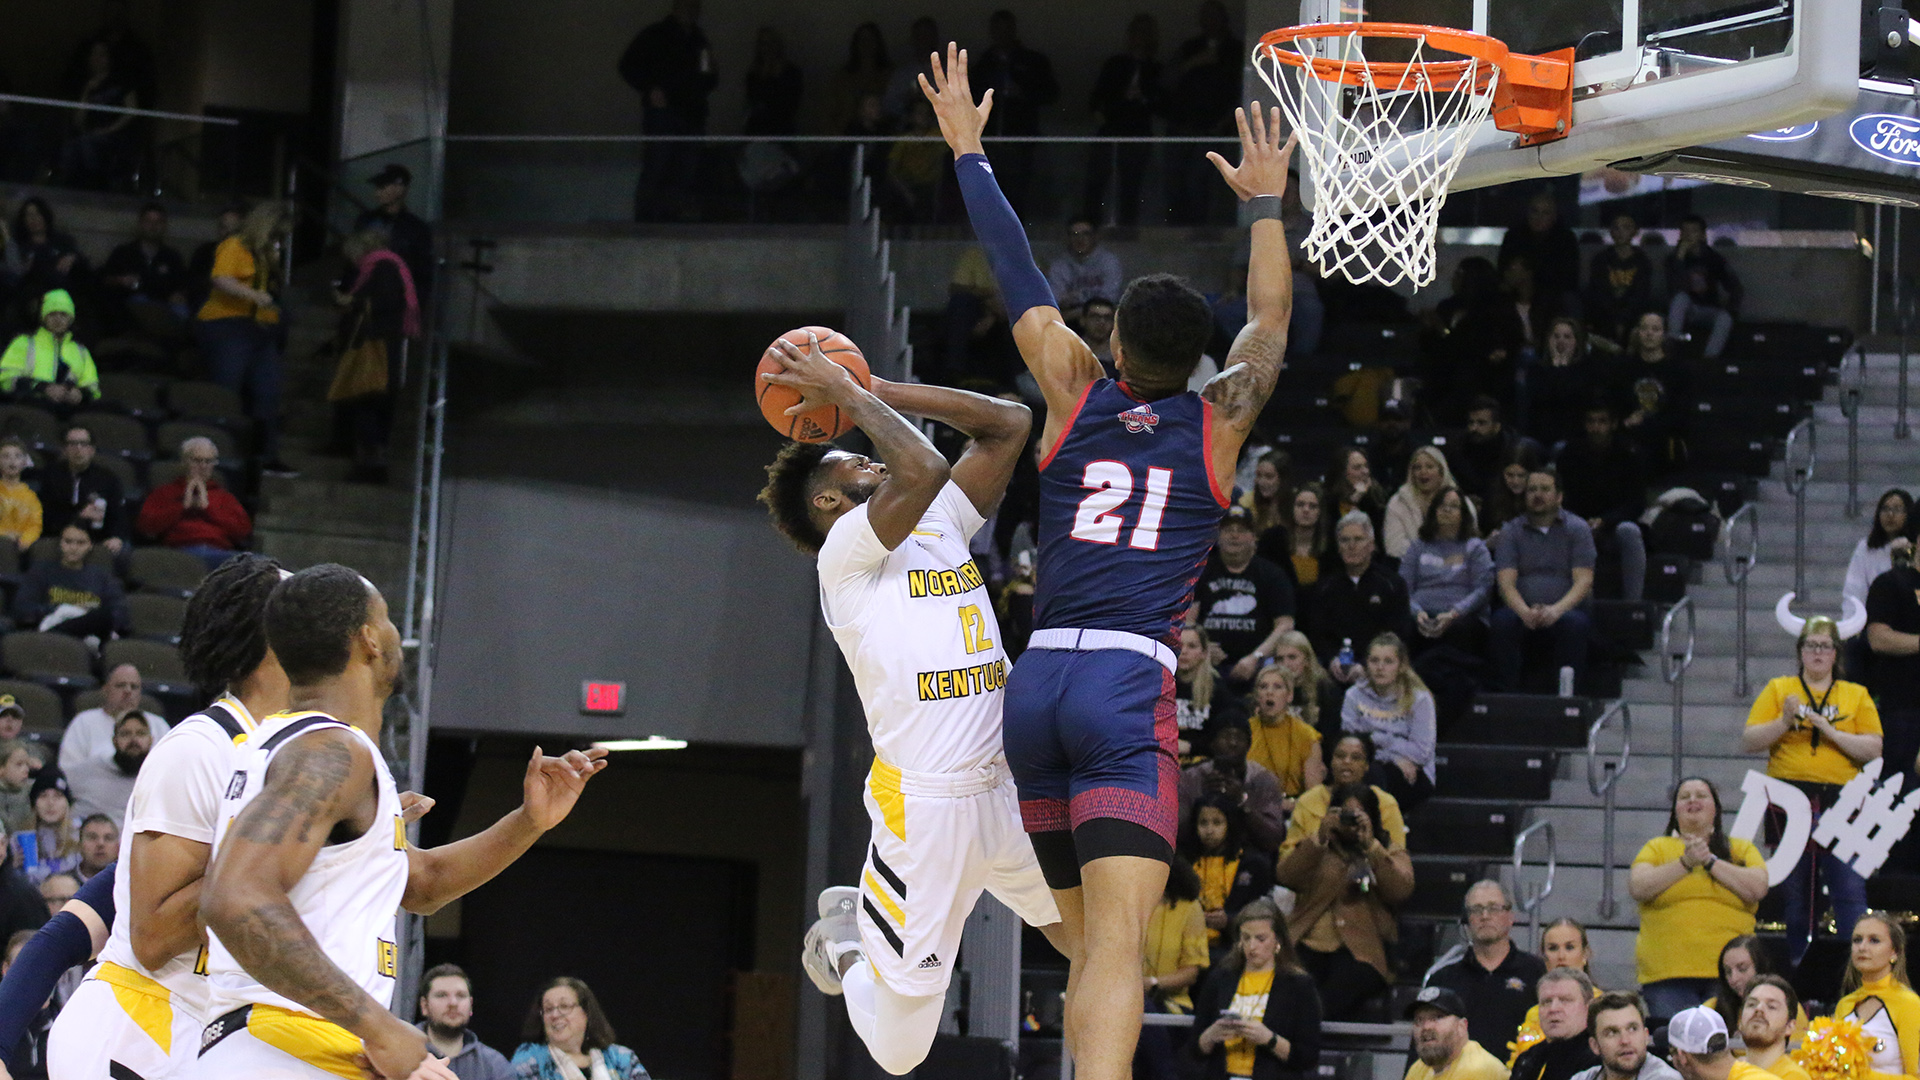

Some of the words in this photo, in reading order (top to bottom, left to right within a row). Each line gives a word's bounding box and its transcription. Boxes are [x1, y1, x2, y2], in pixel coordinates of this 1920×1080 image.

[1870, 119, 1920, 156] For
[1069, 459, 1174, 552] 21
[958, 603, 994, 655] 12
[586, 683, 621, 710] EXIT
[917, 656, 1008, 701] KENTUC
[917, 961, 942, 969] adidas
